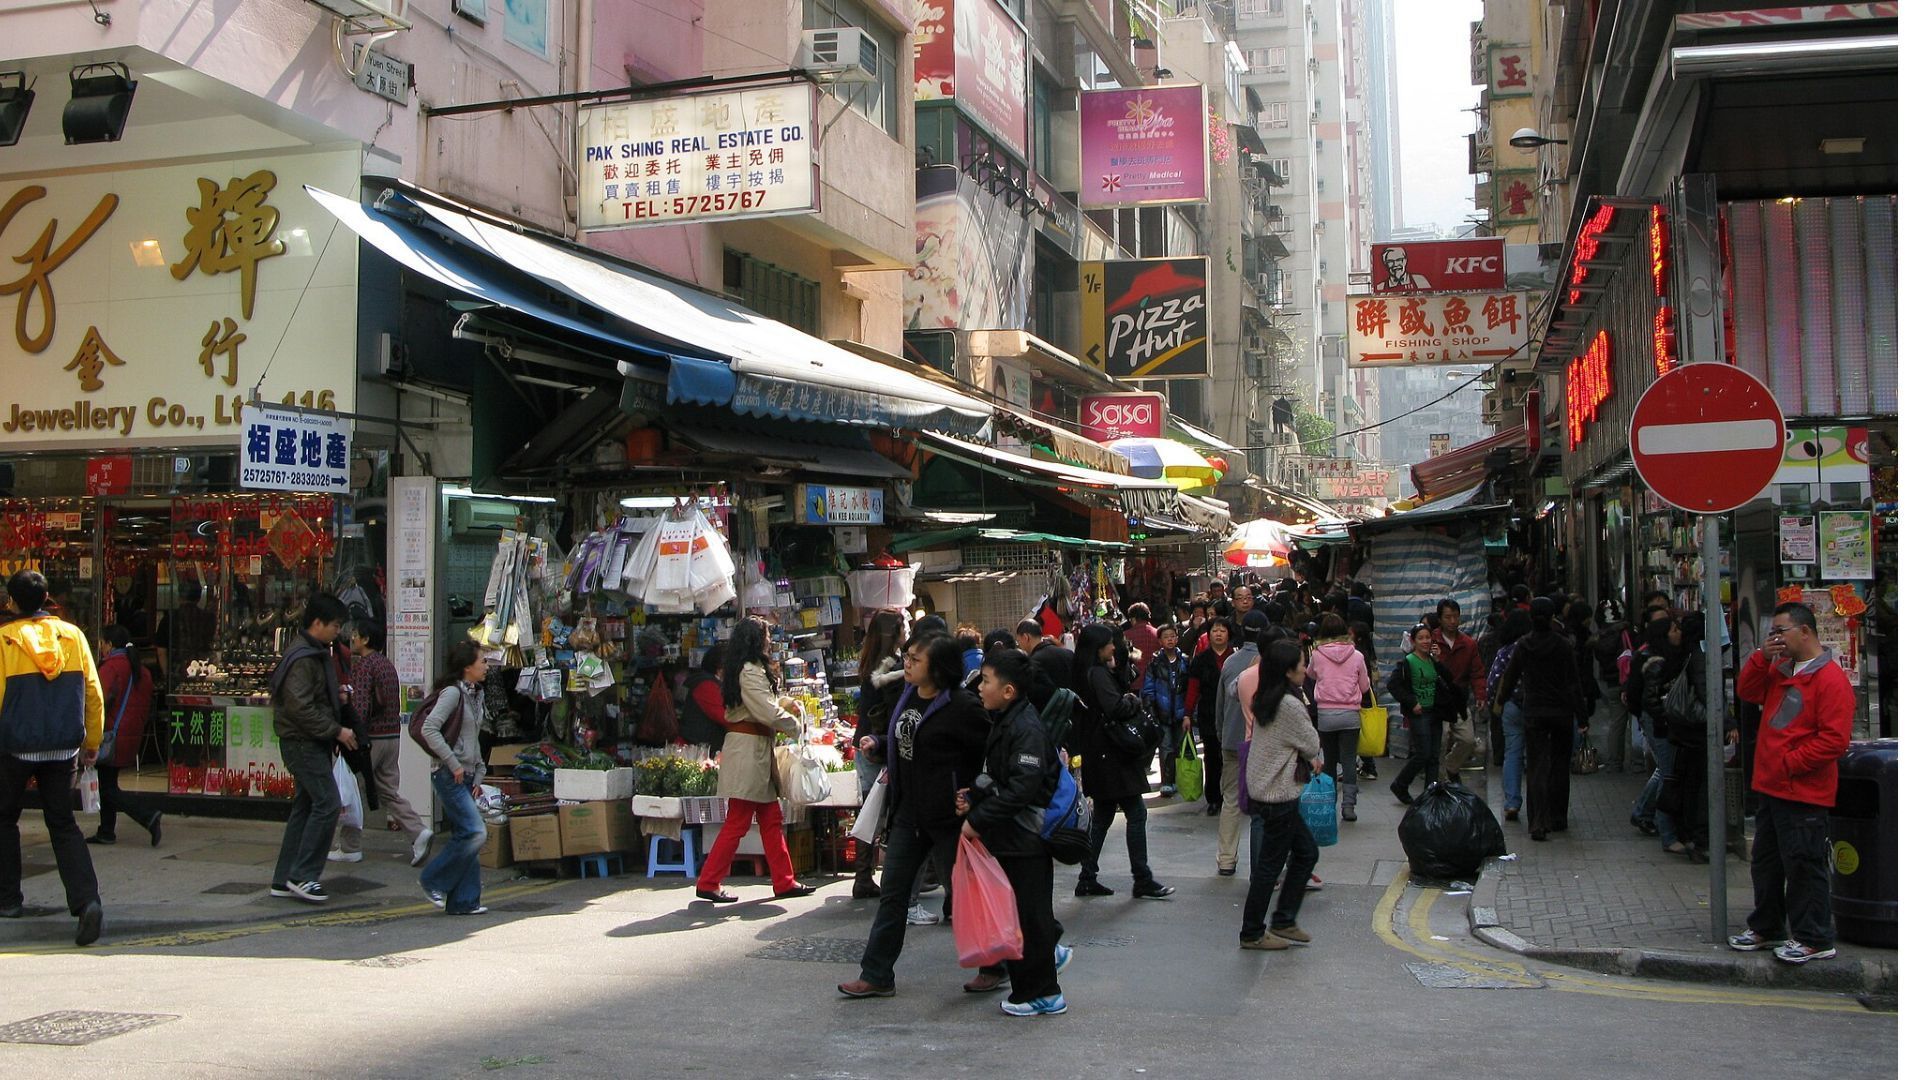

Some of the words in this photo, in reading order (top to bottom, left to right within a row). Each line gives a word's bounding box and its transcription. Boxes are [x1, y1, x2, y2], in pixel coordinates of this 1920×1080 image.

[368, 55, 384, 70] Yuen
[386, 62, 406, 79] Street
[1497, 55, 1527, 88] 玉
[586, 145, 613, 162] PAK
[621, 141, 664, 159] SHING
[671, 136, 710, 154] REAL
[718, 129, 773, 149] ESTATE
[781, 126, 804, 142] CO.
[603, 158, 681, 180] 歡迎委托
[705, 148, 784, 171] 業主免佣
[1149, 170, 1182, 180] Medical
[604, 179, 681, 201] 買賣租售
[705, 168, 784, 191] 樓宇按揭
[623, 190, 766, 219] TEL:5725767
[170, 169, 286, 320] 輝
[1444, 256, 1498, 274] KFC
[1084, 273, 1101, 293] 1/F
[1109, 295, 1205, 358] Pizza
[1356, 294, 1521, 339] 聯盛魚餌
[1126, 319, 1197, 367] Hut
[1385, 338, 1442, 349] FISHING
[1452, 337, 1490, 346] SHOP
[1409, 349, 1468, 362] 巷口直入
[3, 400, 136, 436] Jewellery
[147, 397, 205, 429] Co.,
[214, 393, 261, 425] Lt
[243, 468, 331, 486] 25725767-28332026
[1332, 485, 1384, 497] WEAR
[171, 711, 281, 748] 天然顏色翡
